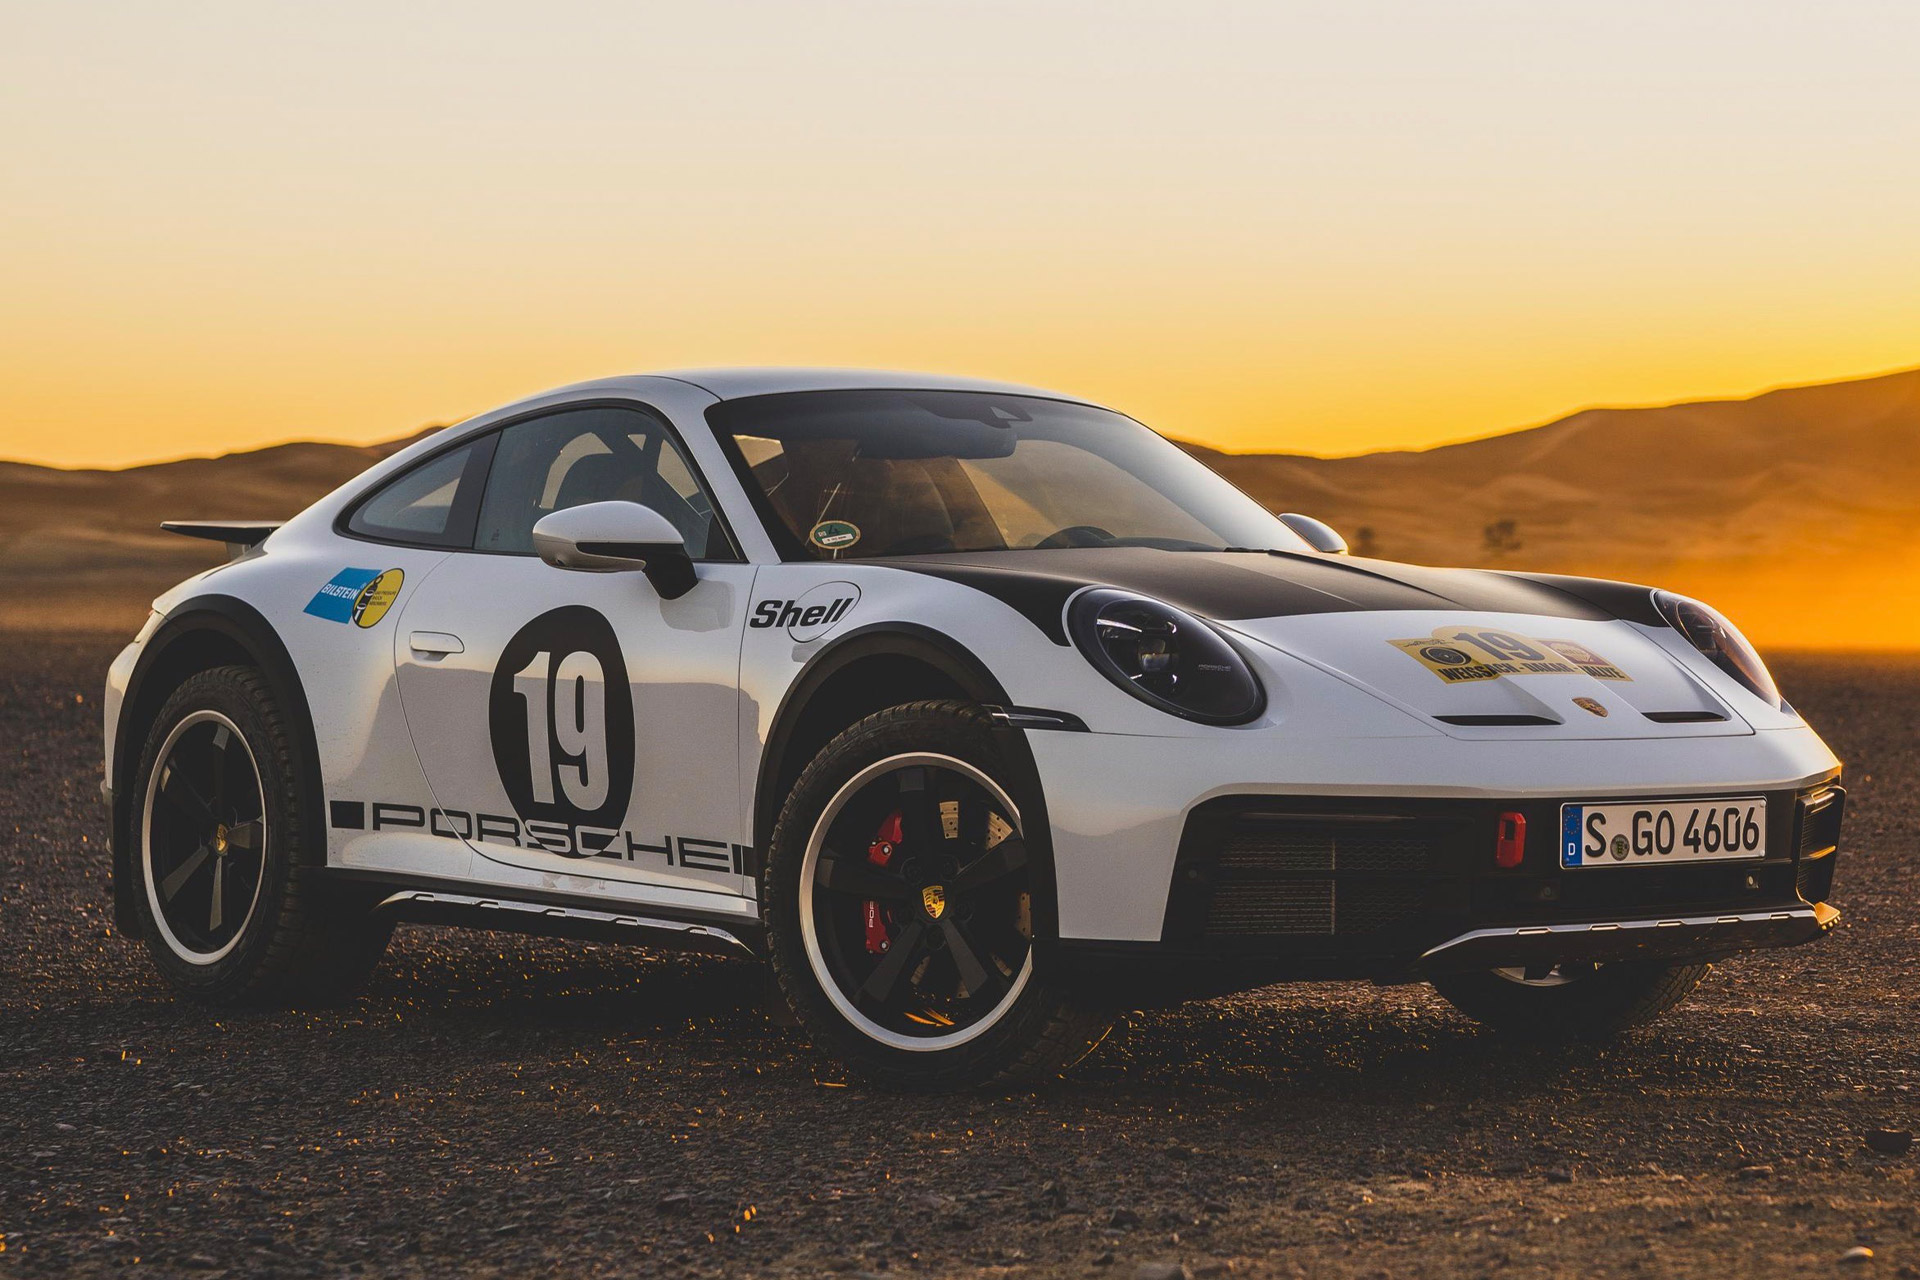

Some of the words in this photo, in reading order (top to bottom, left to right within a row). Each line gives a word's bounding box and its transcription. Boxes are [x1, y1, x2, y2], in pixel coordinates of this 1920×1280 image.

[321, 583, 360, 600] BILSTEIN
[749, 598, 854, 628] Shell
[1453, 632, 1545, 660] 19
[1437, 662, 1521, 681] WEISSACH
[1520, 662, 1575, 673] DAKAR
[513, 650, 610, 811] 19
[372, 802, 731, 873] PORSCHE
[1568, 842, 1576, 856] D
[1585, 812, 1606, 858] S
[1632, 810, 1676, 856] GO
[1683, 807, 1760, 854] 4606
